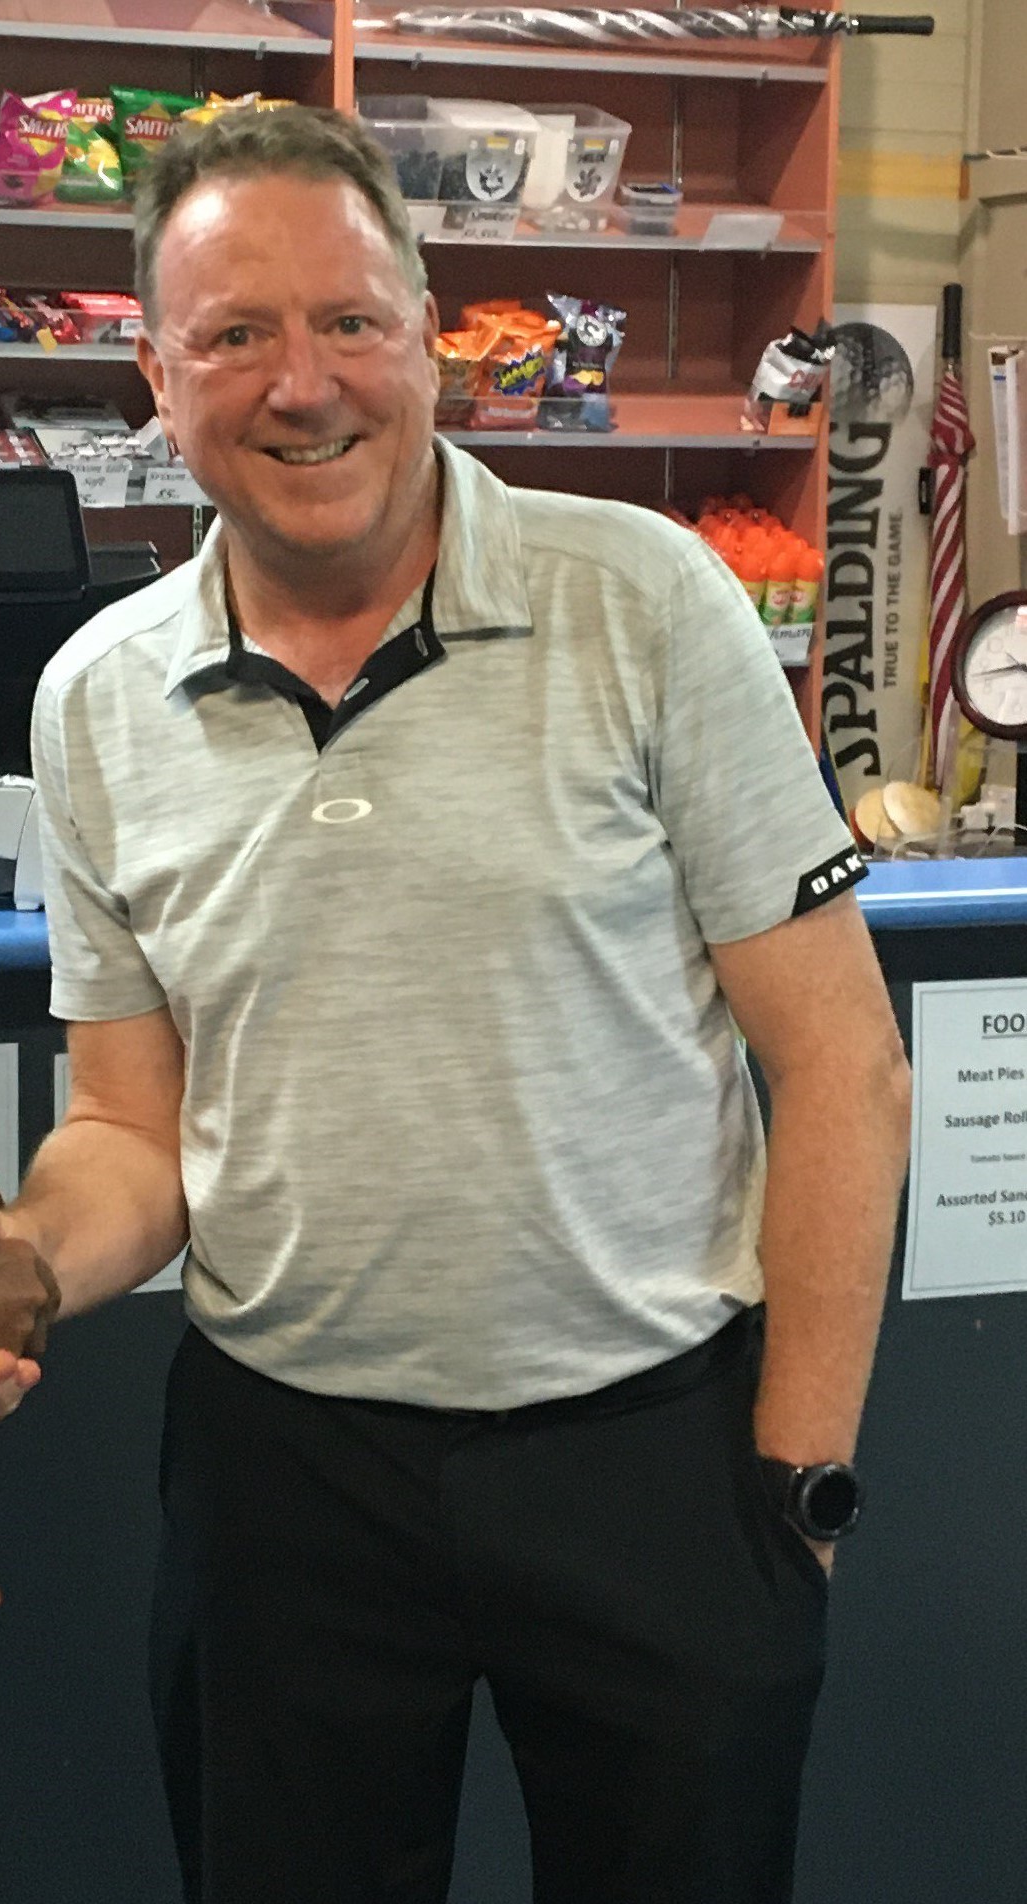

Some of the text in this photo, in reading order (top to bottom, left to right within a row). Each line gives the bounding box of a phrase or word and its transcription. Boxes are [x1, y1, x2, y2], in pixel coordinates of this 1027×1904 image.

[821, 422, 891, 776] SPALDING
[886, 571, 901, 606] THE
[886, 613, 899, 635] TO
[884, 641, 899, 688] TRUE
[982, 1013, 1027, 1034] FOO
[957, 1067, 1026, 1083] Meat Pies
[944, 1114, 1001, 1129] Sausage
[936, 1189, 1027, 1207] Assorted San
[988, 1210, 1026, 1227] $5.10
